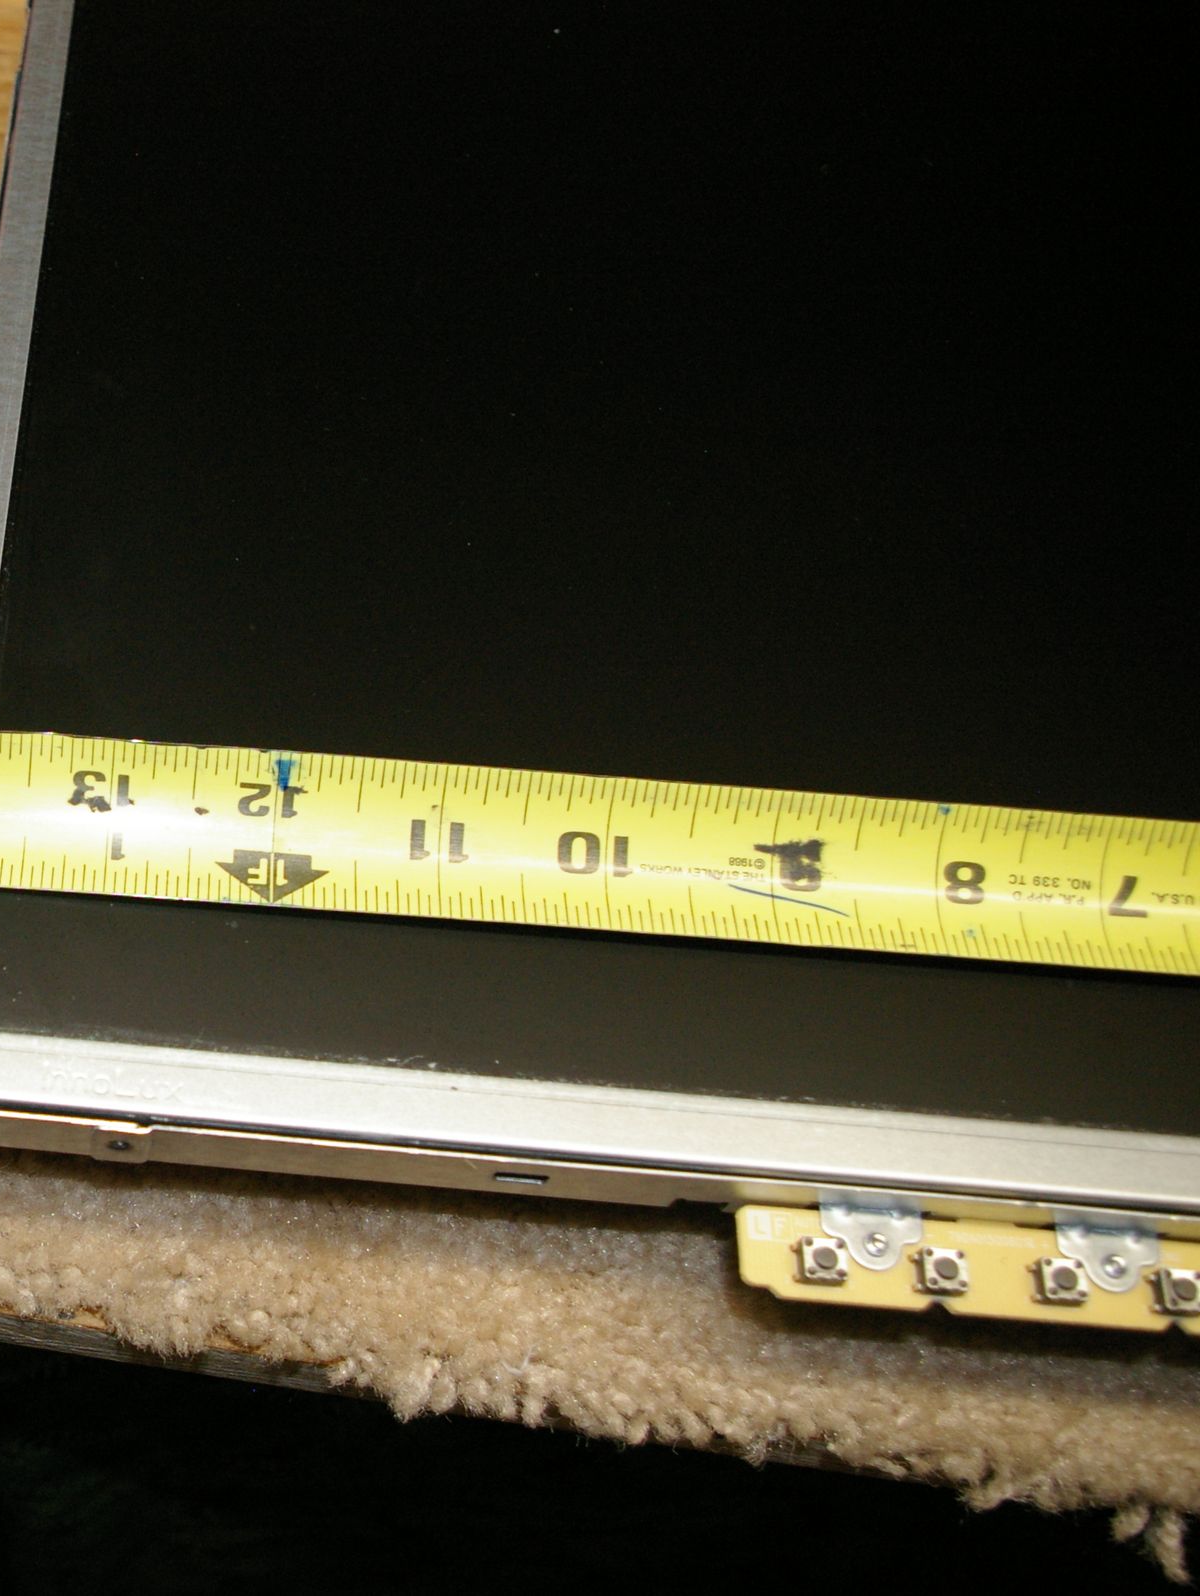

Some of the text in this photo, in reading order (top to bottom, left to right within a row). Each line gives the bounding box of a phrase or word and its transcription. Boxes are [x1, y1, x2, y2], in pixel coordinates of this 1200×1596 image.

[71, 770, 133, 811] 13
[237, 782, 297, 818] 12
[111, 832, 125, 860] 1
[410, 819, 469, 863] 11
[557, 831, 633, 877] 10
[247, 858, 289, 886] 1F
[639, 863, 766, 882] THE STANLEY WORKS
[943, 861, 986, 904] 8
[1008, 874, 1092, 890] NO. 339 TC
[1108, 875, 1149, 918] 7
